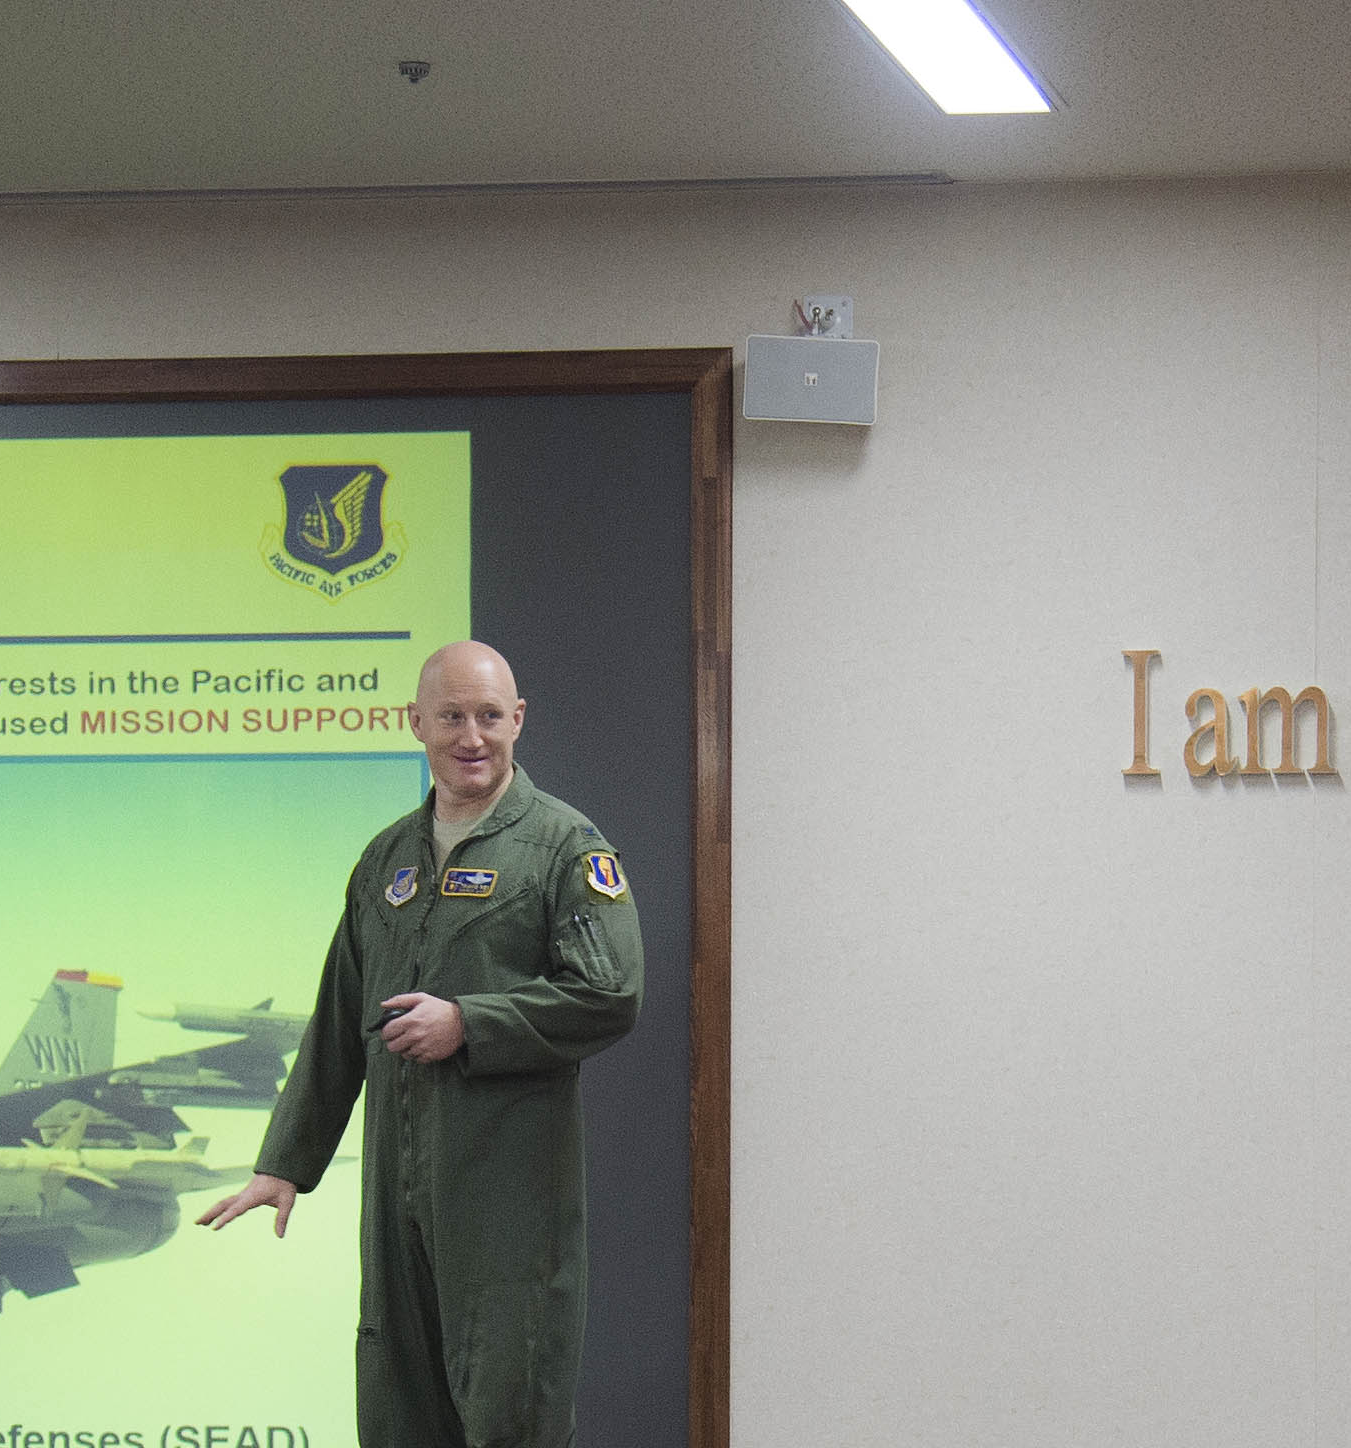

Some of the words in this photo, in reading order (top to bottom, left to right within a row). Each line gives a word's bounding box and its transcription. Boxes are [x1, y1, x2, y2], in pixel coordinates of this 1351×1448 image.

[269, 552, 316, 586] PACIFIC
[319, 580, 342, 599] AIR
[346, 551, 398, 587] FORCES
[89, 670, 116, 695] in
[127, 669, 180, 695] the
[192, 667, 305, 694] Pacific
[316, 667, 379, 692] and
[80, 708, 229, 735] MISSION
[242, 706, 407, 733] SUPPORT
[1121, 650, 1162, 775] I
[1183, 685, 1340, 778] am
[24, 1032, 83, 1076] WW
